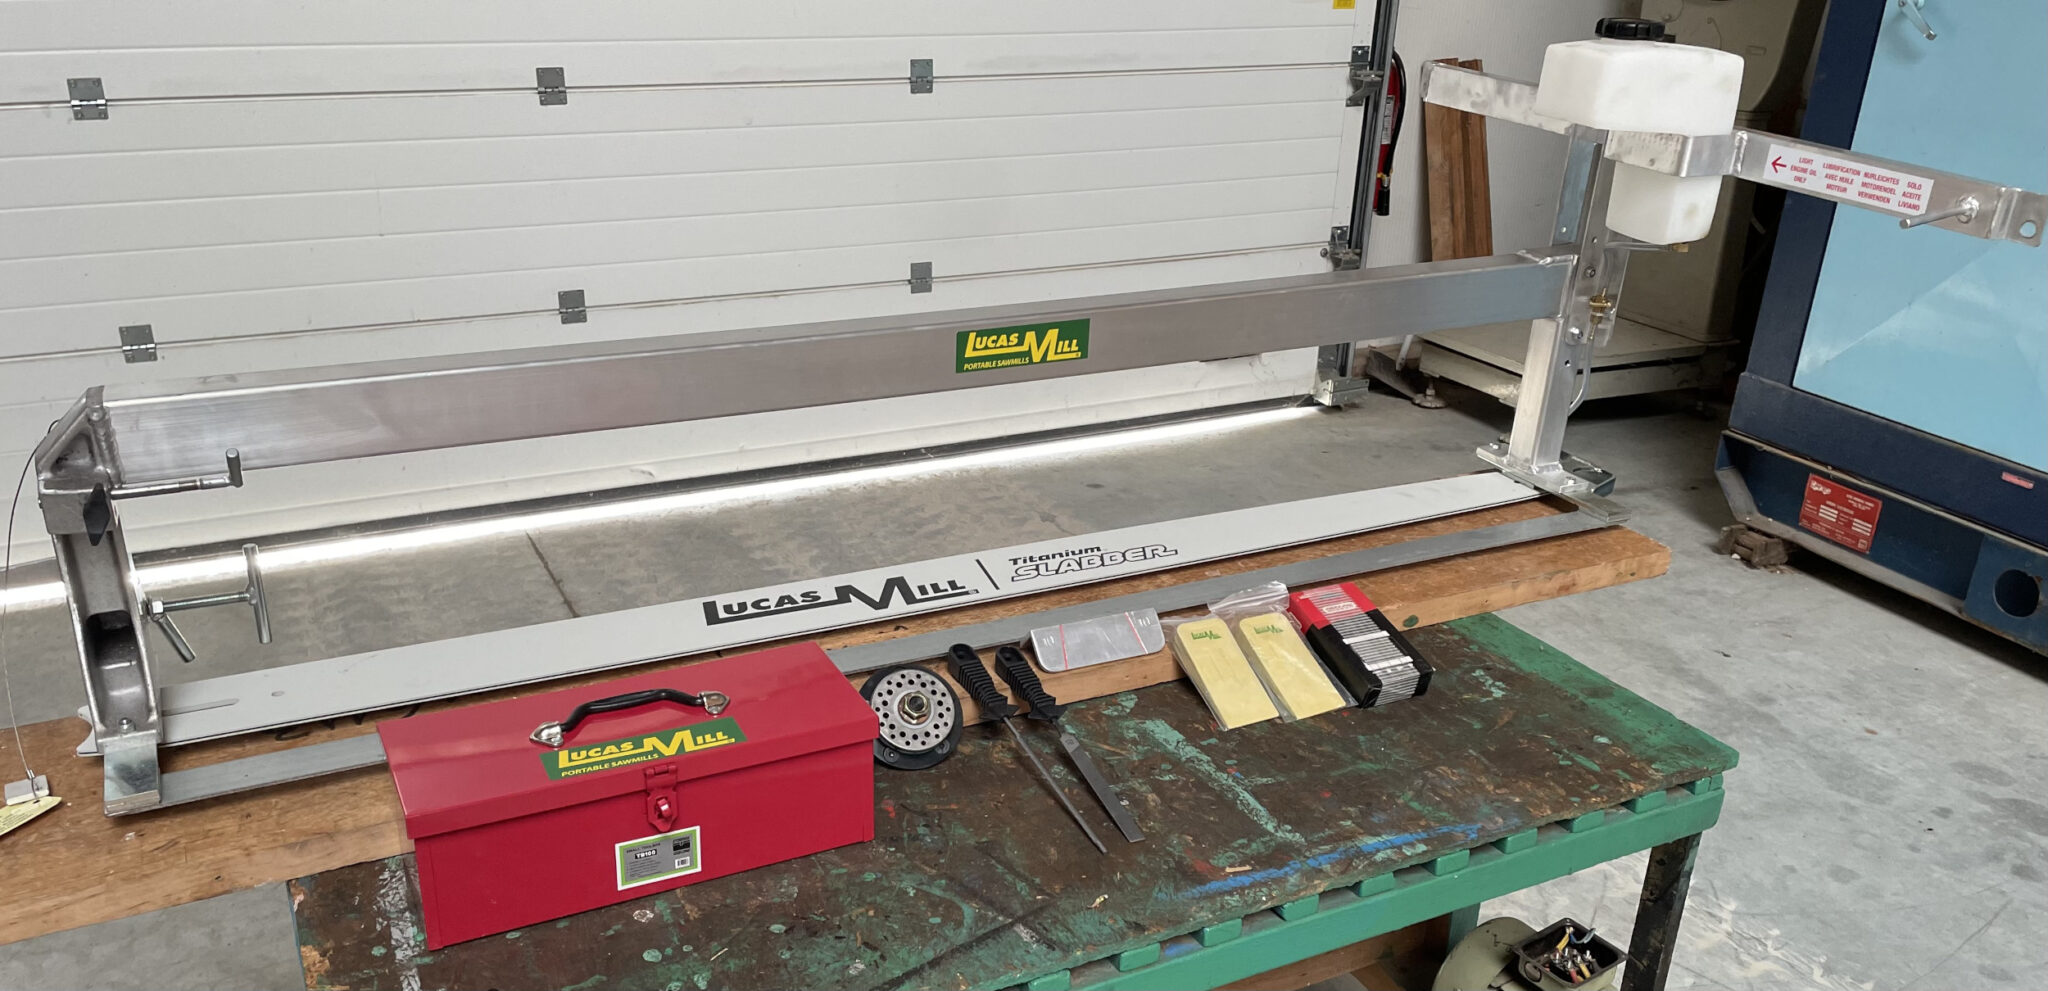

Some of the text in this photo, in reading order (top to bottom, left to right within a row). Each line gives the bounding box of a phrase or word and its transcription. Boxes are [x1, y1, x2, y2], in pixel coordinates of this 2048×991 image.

[1790, 165, 1808, 174] ENGINE
[1823, 162, 1861, 176] LUBRIFICATION
[1794, 175, 1807, 183] ONLY
[1825, 173, 1854, 185] AVEC HUILE
[1826, 183, 1847, 193] MOTEUR
[1907, 181, 1922, 191] SOLO
[1857, 191, 1891, 204] VERWENDEN
[1902, 191, 1922, 201] ACEITE
[1897, 200, 1920, 211] LIVIANO
[965, 328, 1081, 362] LUCAS MILL
[964, 357, 1029, 370] PORTABLE SAWMILLS
[1008, 546, 1102, 566] Titanium
[702, 575, 979, 626] LUCAS MILL
[558, 729, 735, 769] LUCAS MILL
[561, 753, 659, 777] PORTABLE SAWMILLS
